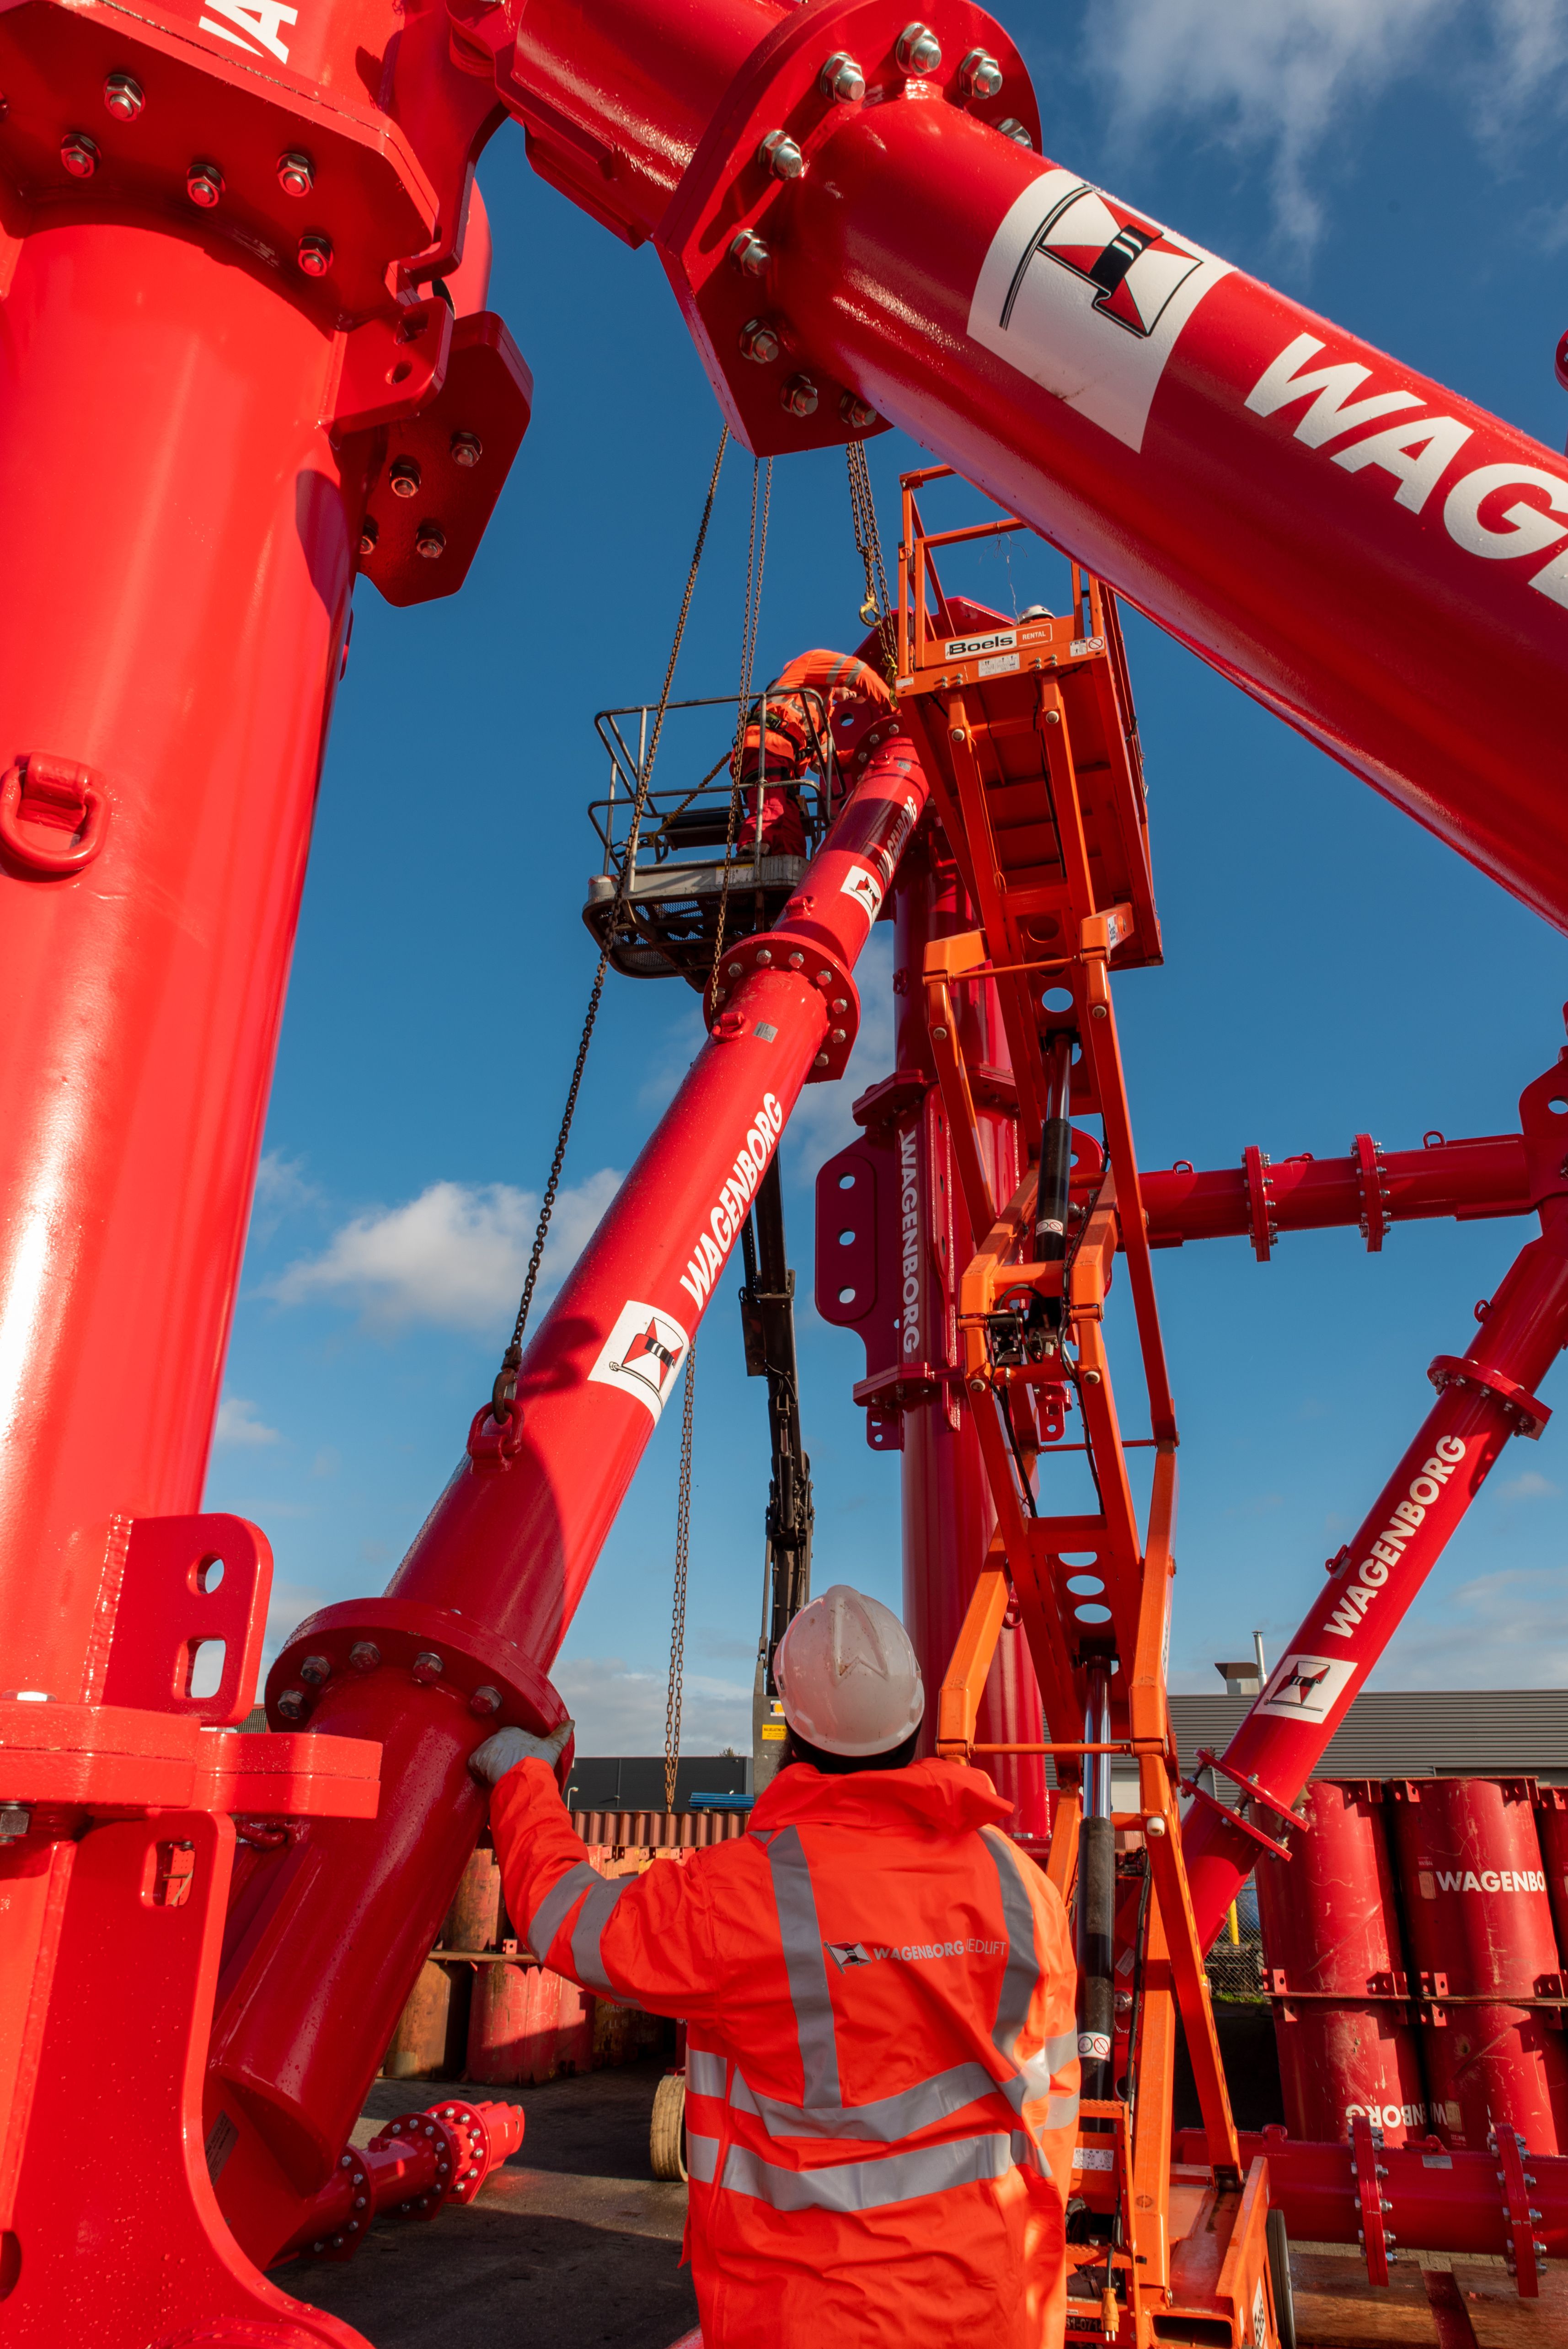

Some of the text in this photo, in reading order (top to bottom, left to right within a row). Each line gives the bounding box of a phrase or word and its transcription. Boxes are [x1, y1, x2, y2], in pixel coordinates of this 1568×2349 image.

[949, 631, 1046, 655] Boels RENTAL
[876, 795, 917, 887] WAGENBORG
[680, 1093, 783, 1311] WAGENBORG
[899, 1130, 919, 1353] WAGENBORG
[1323, 1435, 1466, 1638] WAGENBORG
[1435, 1871, 1547, 1892] WAGENBO
[873, 1940, 963, 1961] WAGENBORG
